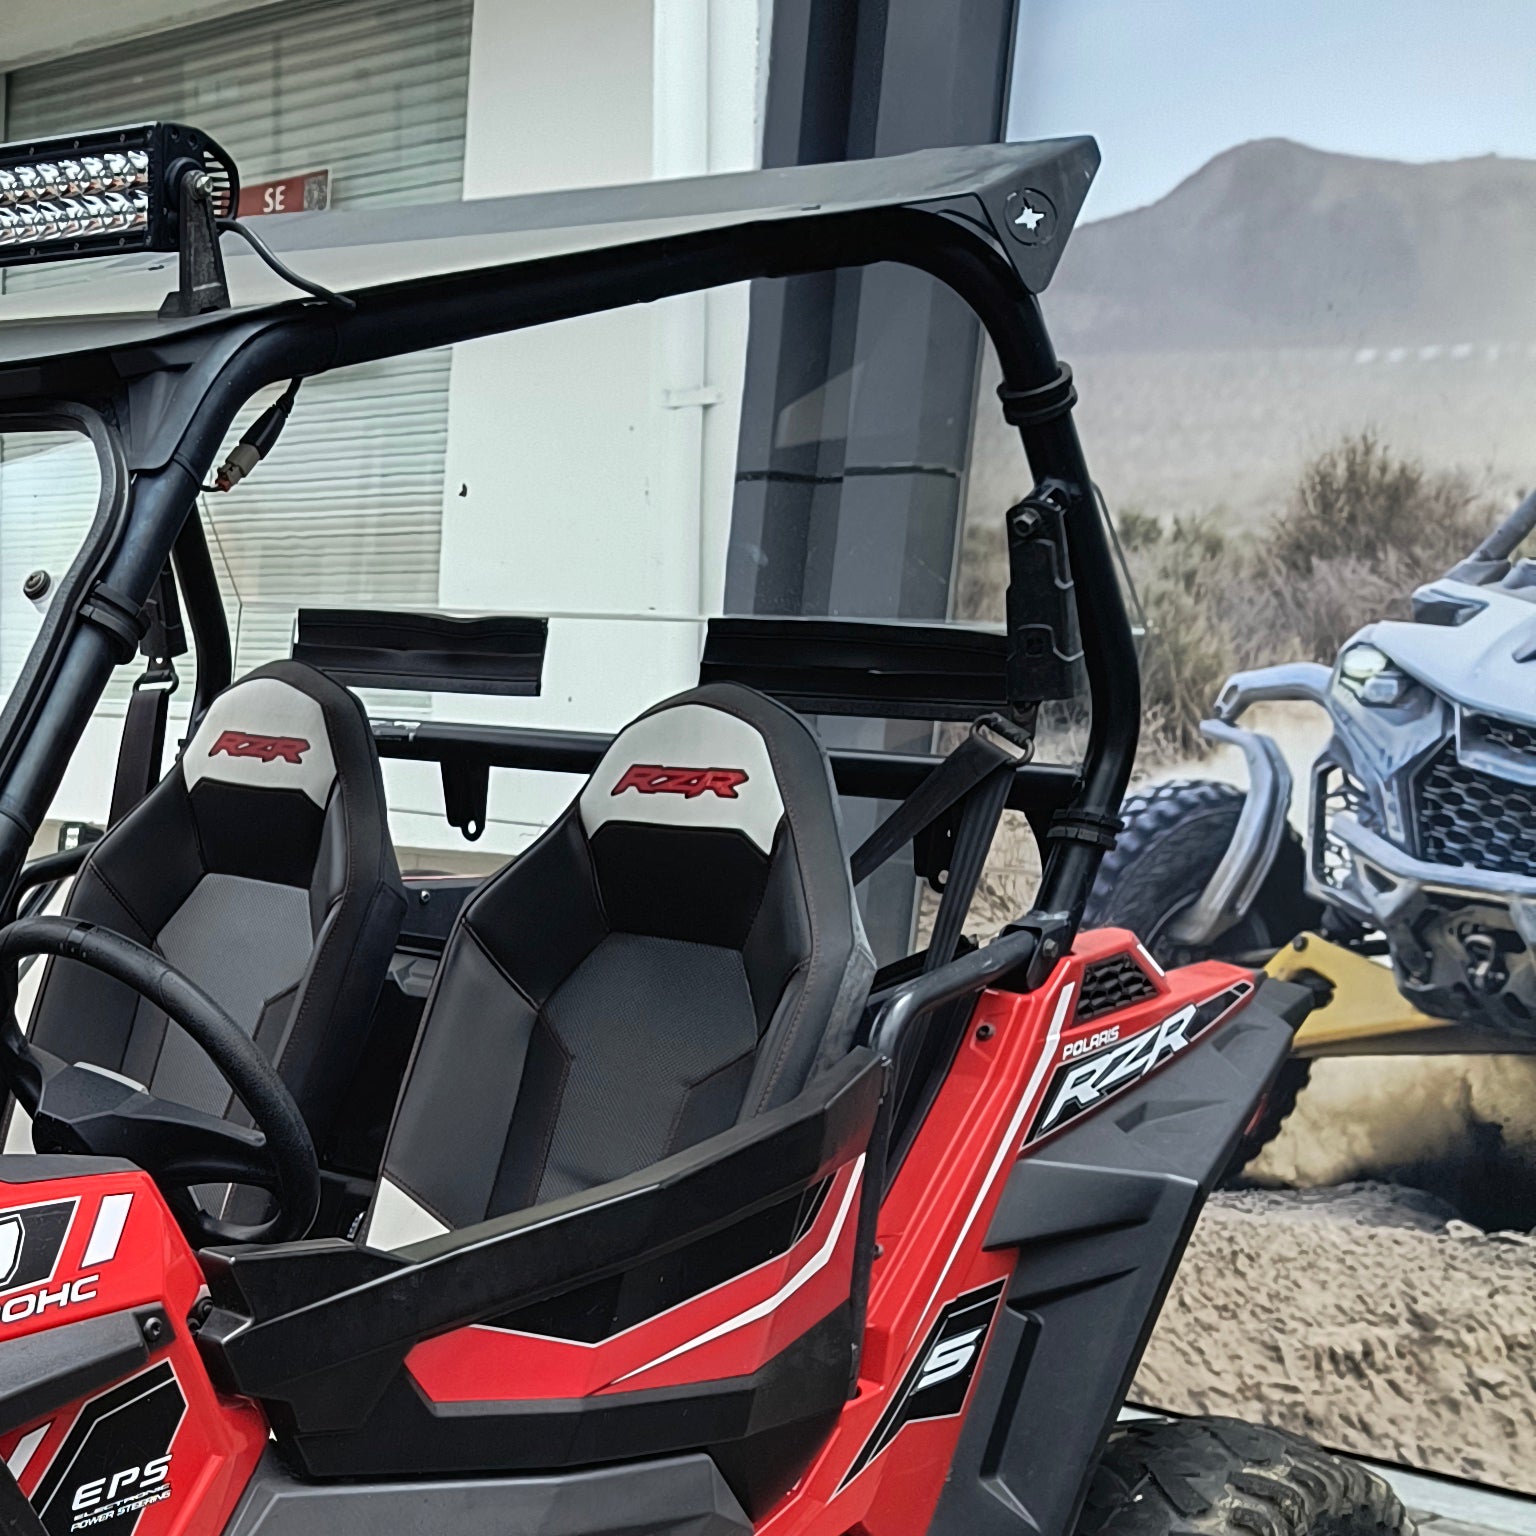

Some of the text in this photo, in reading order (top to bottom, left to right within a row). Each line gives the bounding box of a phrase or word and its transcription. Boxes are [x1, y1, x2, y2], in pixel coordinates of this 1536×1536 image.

[263, 185, 286, 213] SE
[208, 730, 311, 764] RZR
[611, 764, 749, 799] RZR
[1062, 1026, 1120, 1060] POLARIS
[1040, 1003, 1199, 1130] RZR
[912, 1325, 986, 1392] S
[72, 1454, 172, 1511] EPS
[71, 1490, 172, 1533] POWER STEERING
